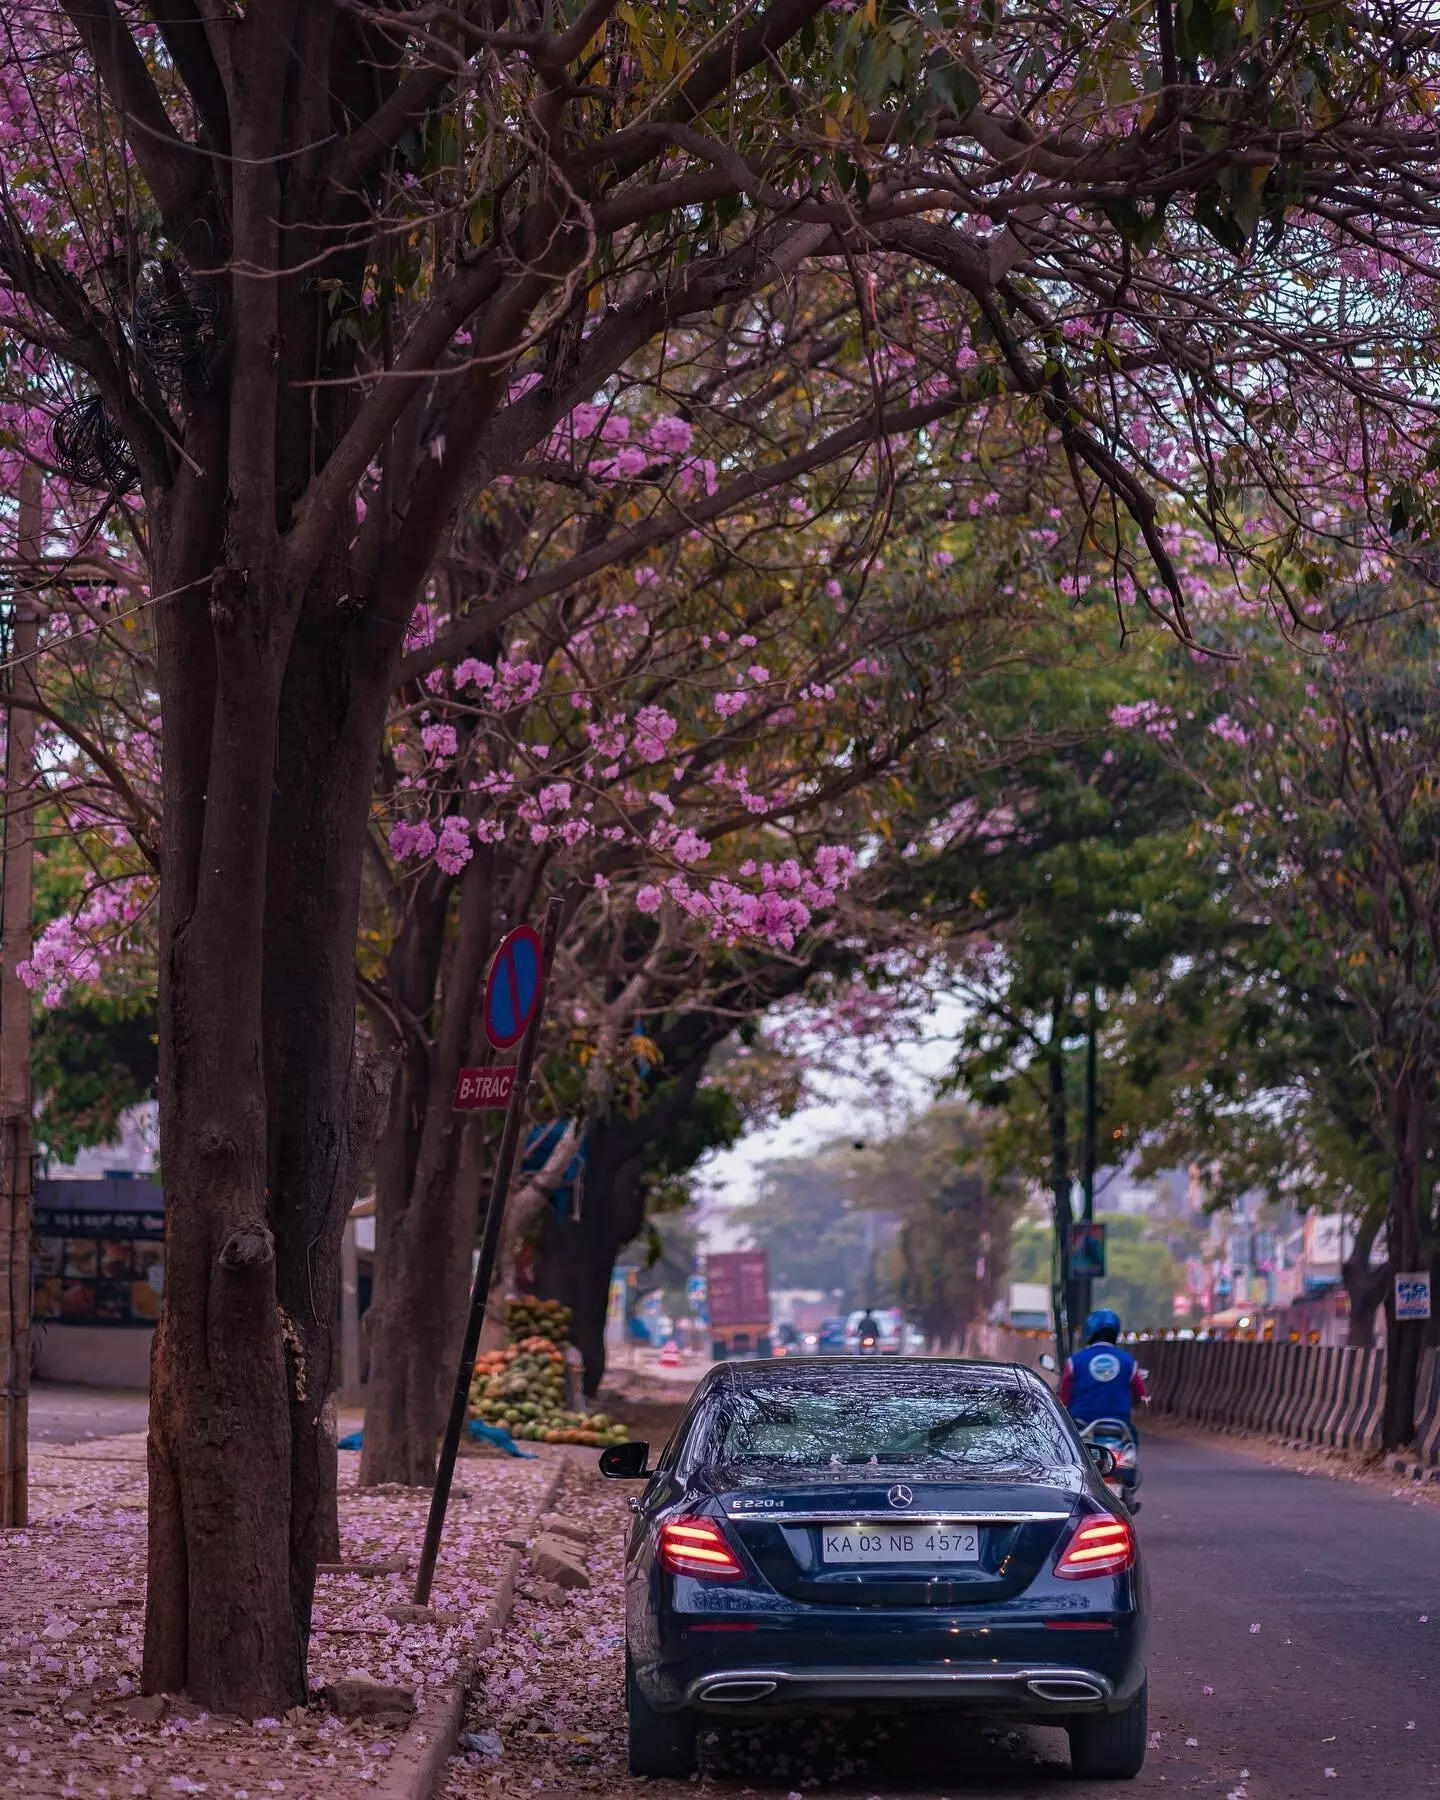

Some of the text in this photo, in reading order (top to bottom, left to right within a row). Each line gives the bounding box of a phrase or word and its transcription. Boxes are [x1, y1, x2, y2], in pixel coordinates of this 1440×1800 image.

[460, 1076, 510, 1099] B-TRAC
[826, 1535, 975, 1552] KA 03 NB 4572
